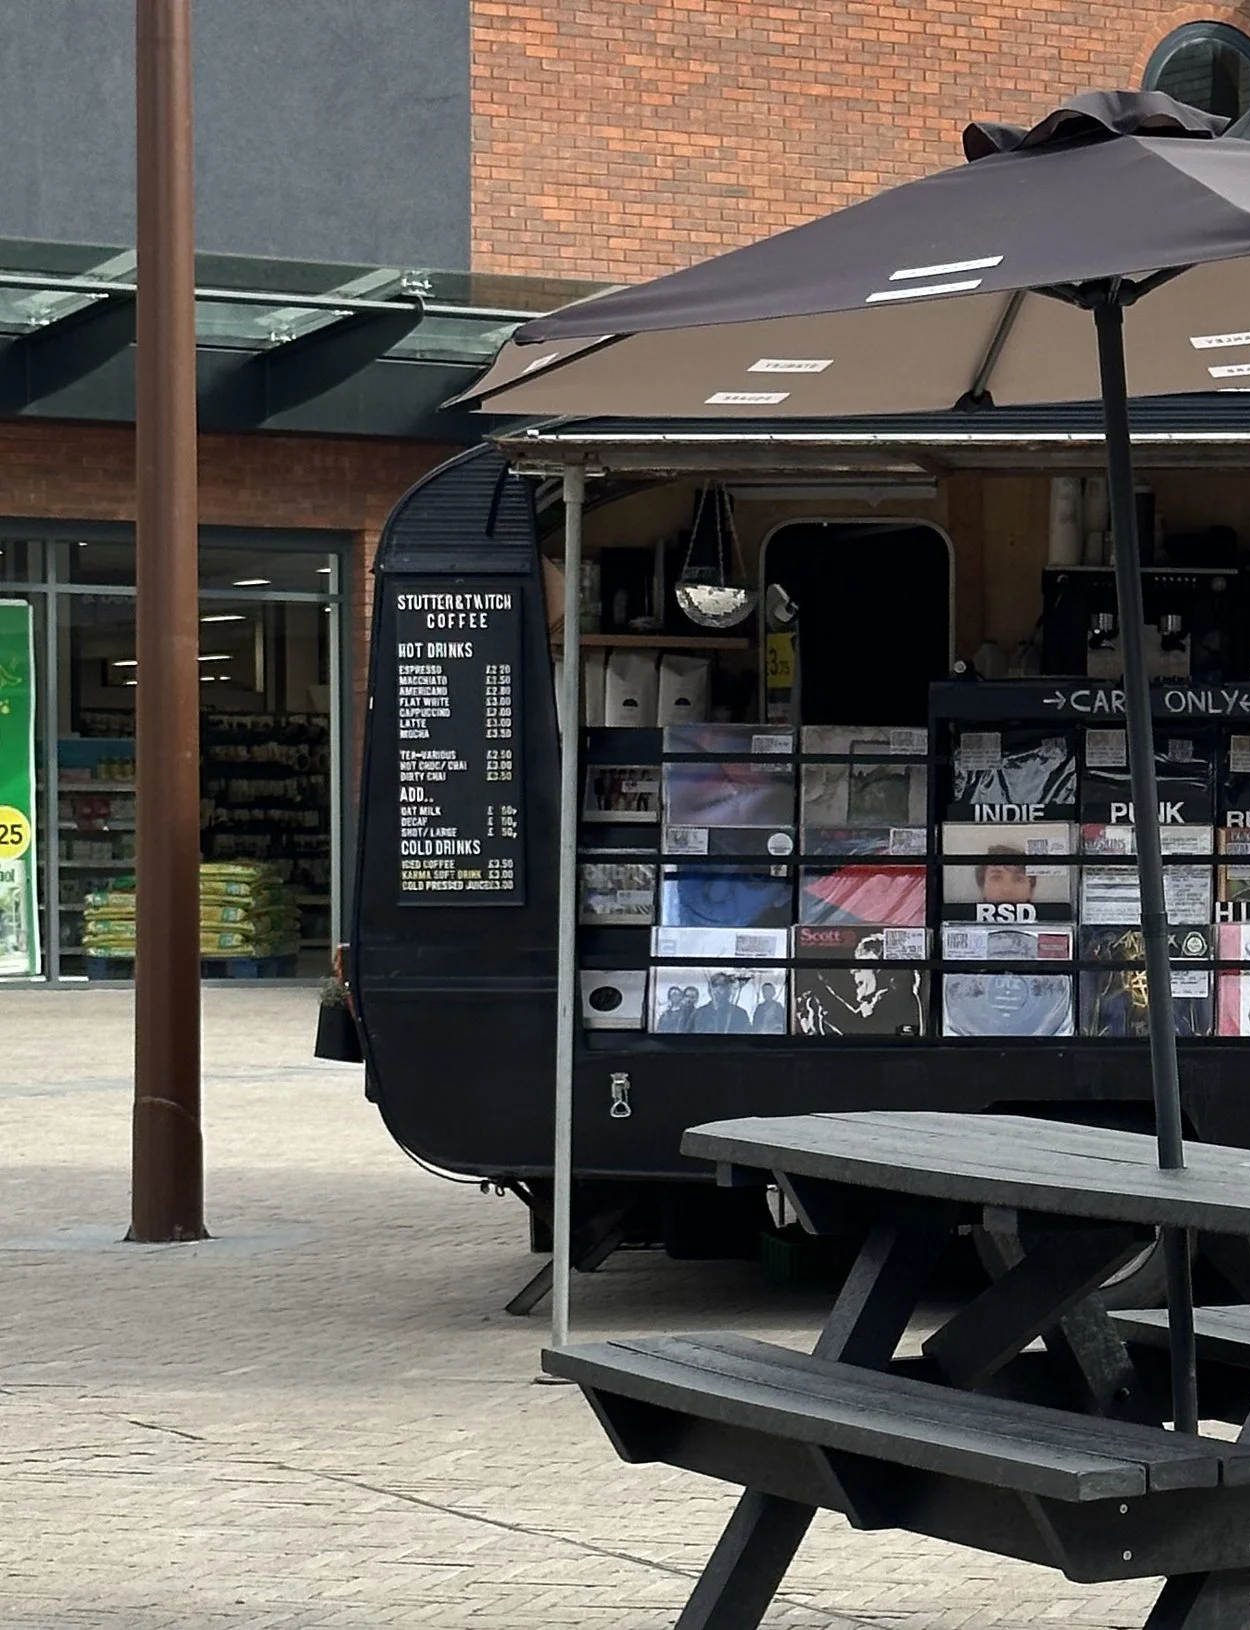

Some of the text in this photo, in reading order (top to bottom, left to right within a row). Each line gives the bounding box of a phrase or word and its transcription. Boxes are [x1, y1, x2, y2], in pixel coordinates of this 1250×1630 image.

[397, 594, 511, 610] STUTTER&TWITCH
[427, 613, 488, 629] COFFEE
[399, 642, 474, 659] HOT DRINKS
[399, 665, 442, 675] ESPRESSO
[399, 676, 448, 685] MACCHIATO
[399, 686, 448, 696] AMERICANO
[400, 697, 421, 707] FLAT
[422, 697, 450, 707] WHITE
[1165, 690, 1238, 715] ONLY
[399, 708, 451, 718] CAPPUCCINO
[400, 719, 427, 728] LATTE
[400, 729, 430, 739] MOCHA
[400, 761, 417, 770] HOT
[400, 771, 425, 782] DIRTY
[426, 771, 447, 781] CHAI
[401, 806, 418, 816] OAT
[419, 806, 441, 816] MILK
[401, 817, 428, 827] DECAF
[401, 840, 481, 856] COLD DRINKS
[401, 860, 421, 870] ICED
[422, 860, 455, 870] COFFEE
[402, 871, 432, 880] KARMA
[433, 871, 456, 880] SOFT
[402, 882, 424, 891] COLD
[976, 902, 1037, 923] RSD
[800, 928, 841, 943] Scott
